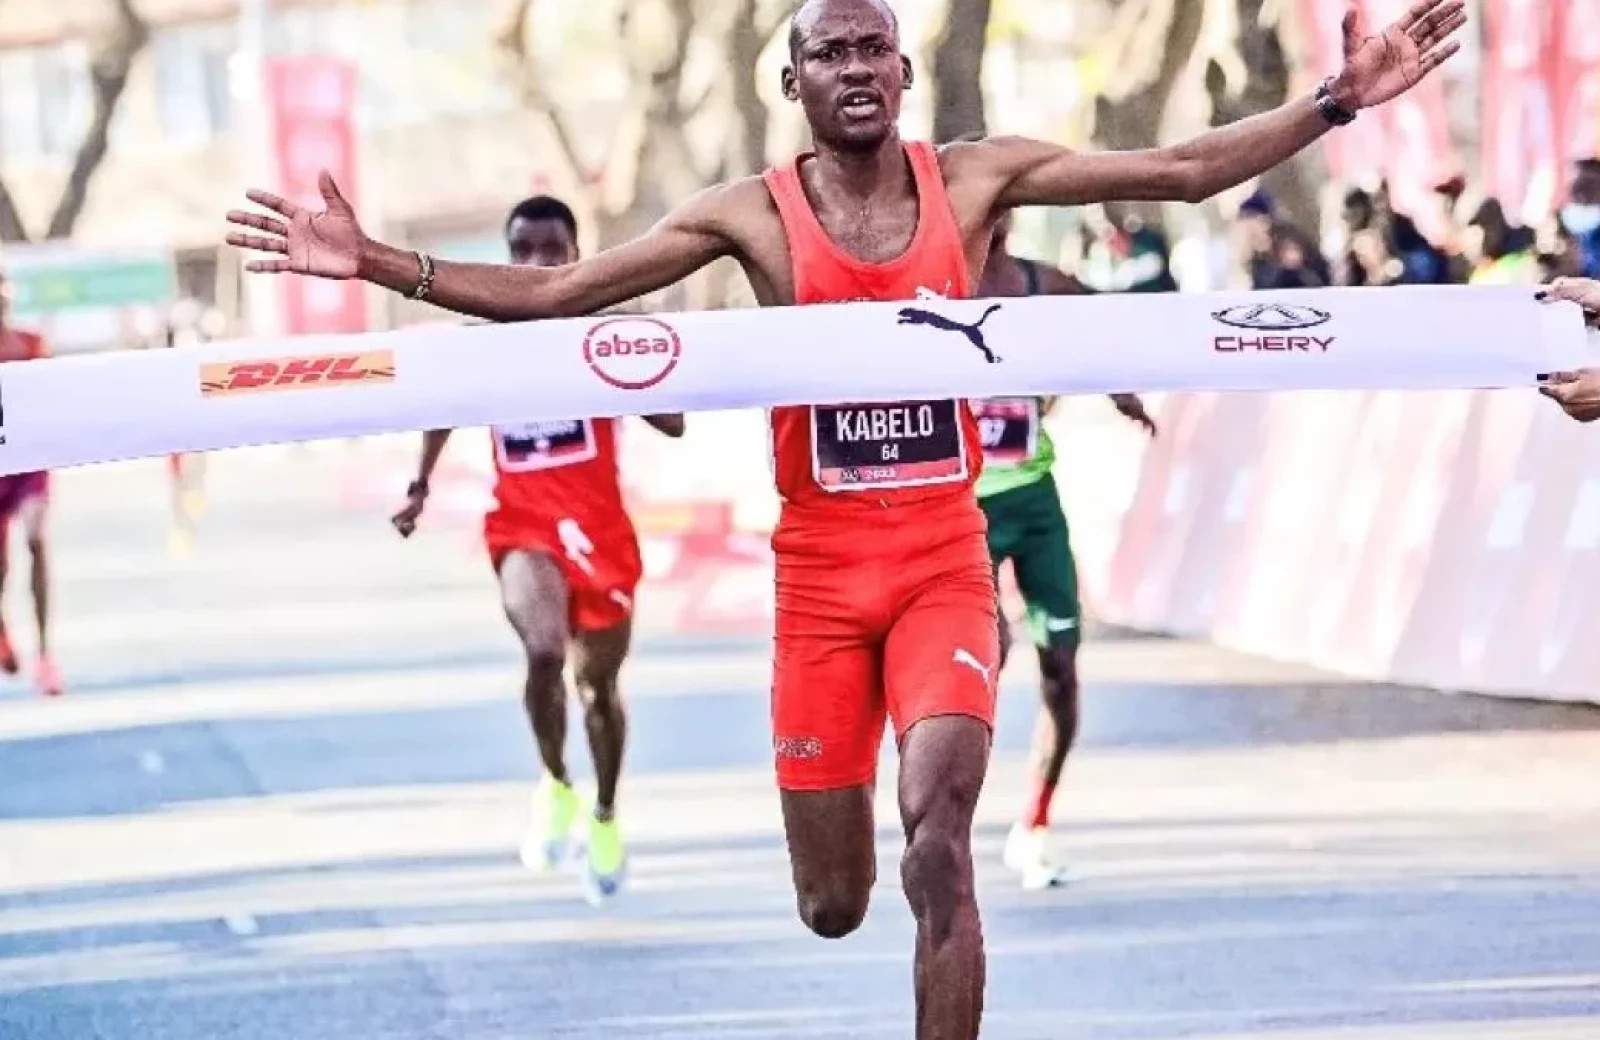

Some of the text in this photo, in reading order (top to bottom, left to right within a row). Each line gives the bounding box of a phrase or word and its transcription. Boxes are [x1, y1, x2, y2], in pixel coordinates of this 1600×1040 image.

[595, 334, 669, 357] absa
[1214, 336, 1336, 352] CHERY
[228, 357, 368, 390] DHL
[836, 405, 934, 442] KABELO
[882, 443, 899, 461] 64
